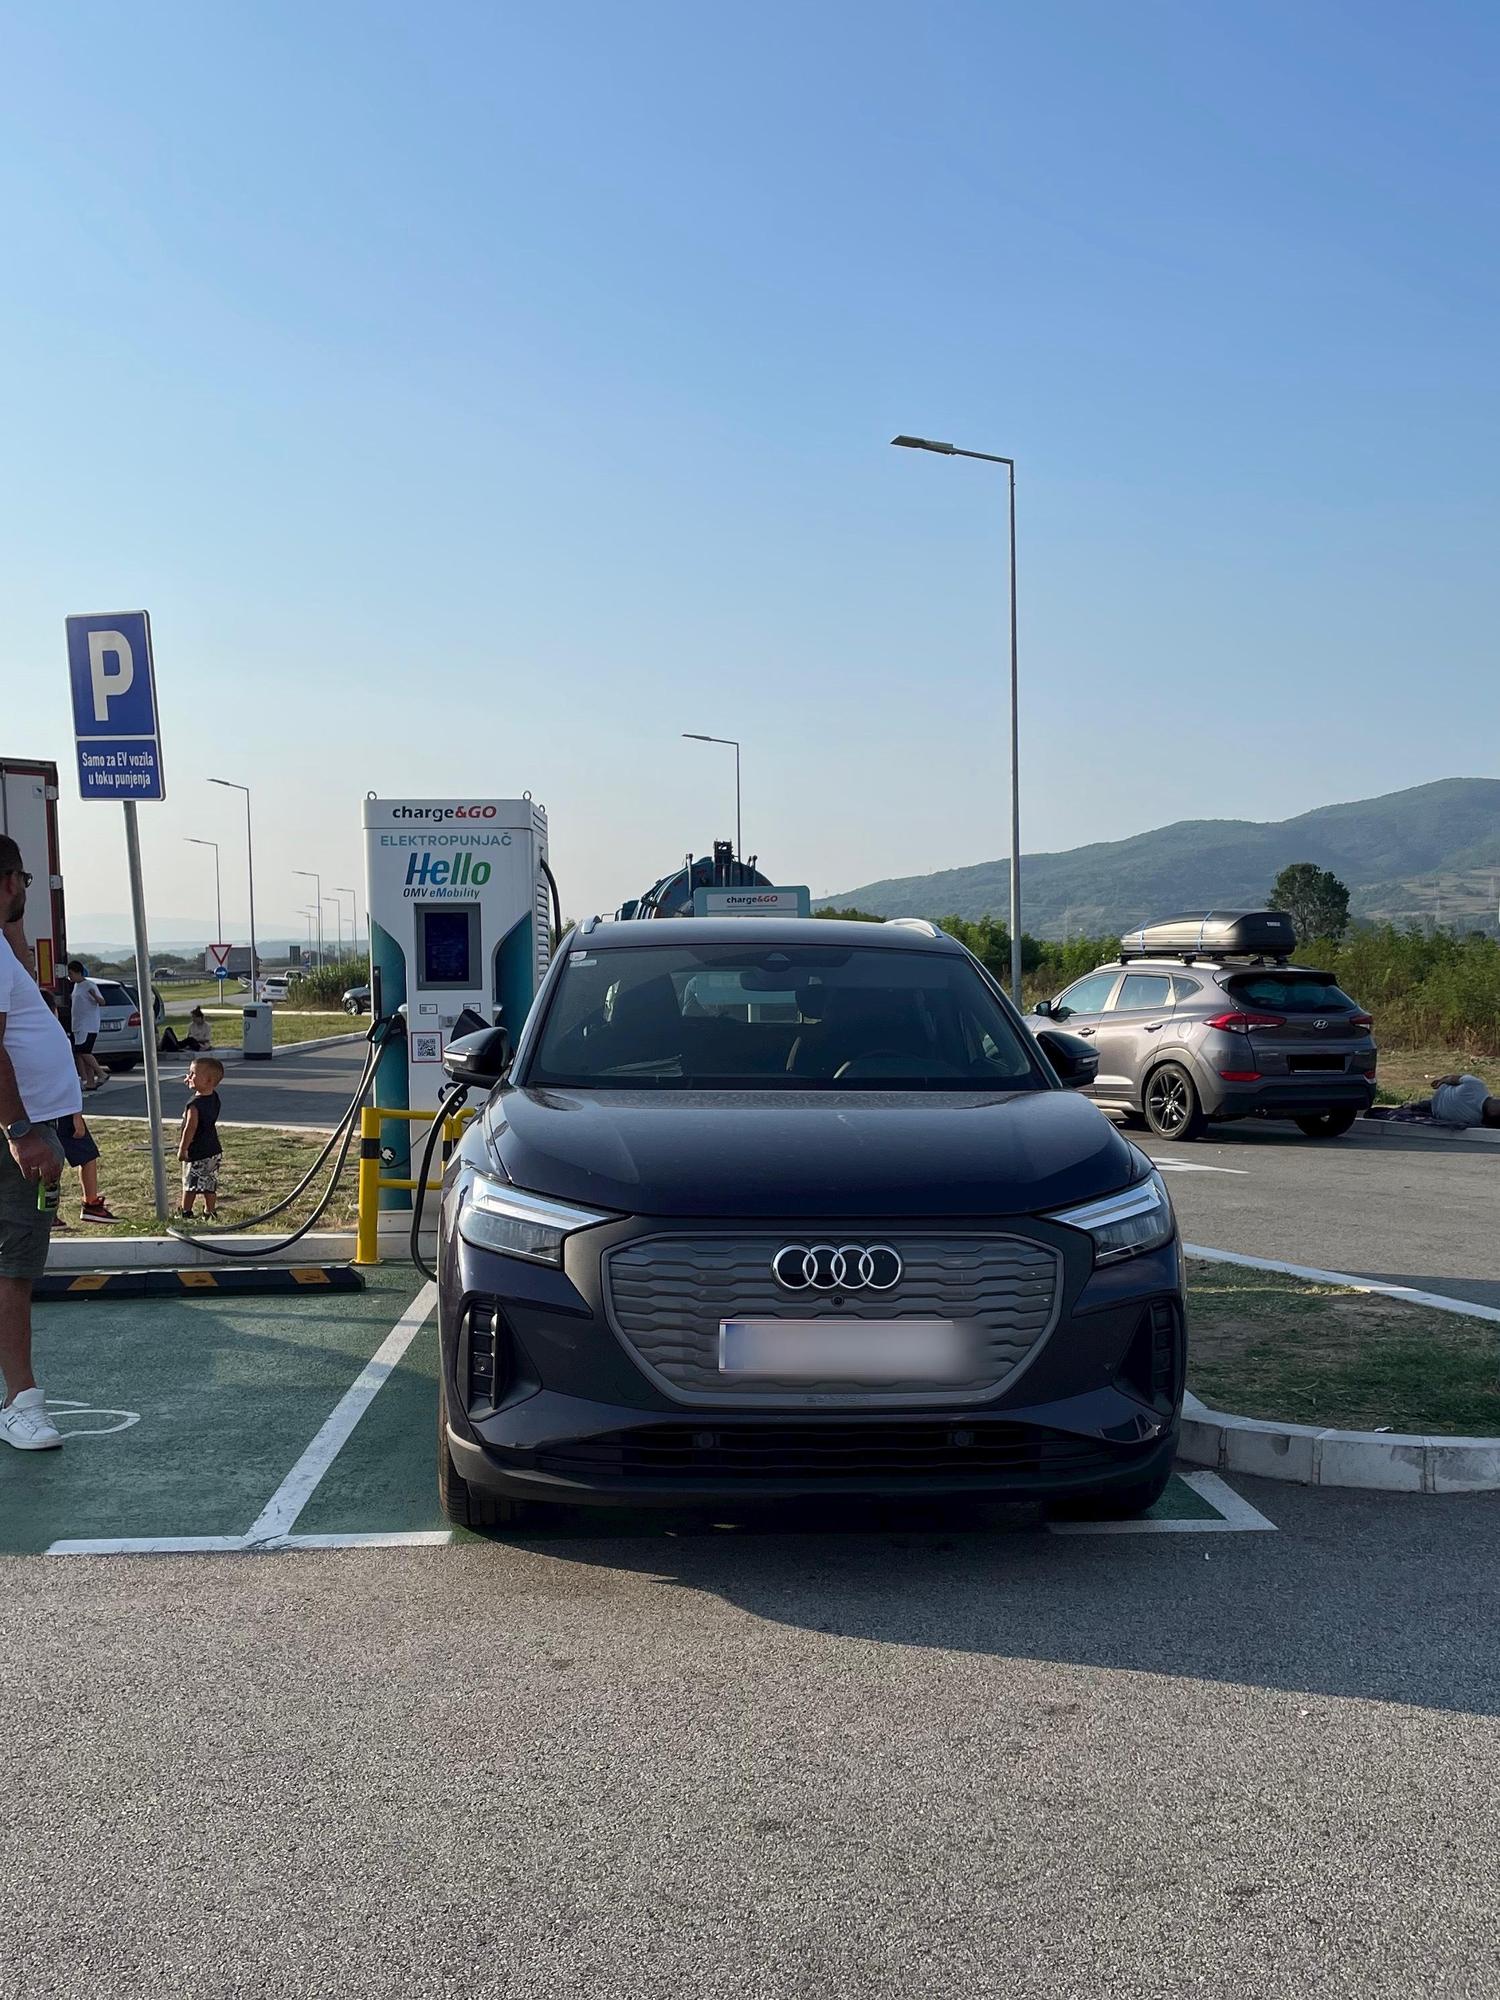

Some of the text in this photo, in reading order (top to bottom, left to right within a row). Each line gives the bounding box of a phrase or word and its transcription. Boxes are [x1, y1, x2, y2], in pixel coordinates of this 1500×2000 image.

[87, 630, 134, 721] P
[82, 751, 153, 767] Samo za EV vozila
[88, 770, 151, 788] u toku punjenja
[392, 806, 497, 822] charge&GO
[380, 832, 512, 846] ELEKTROPUNJAČ
[405, 852, 492, 886] Hello
[403, 887, 480, 900] OMV eMobility
[726, 895, 778, 905] charge&GO
